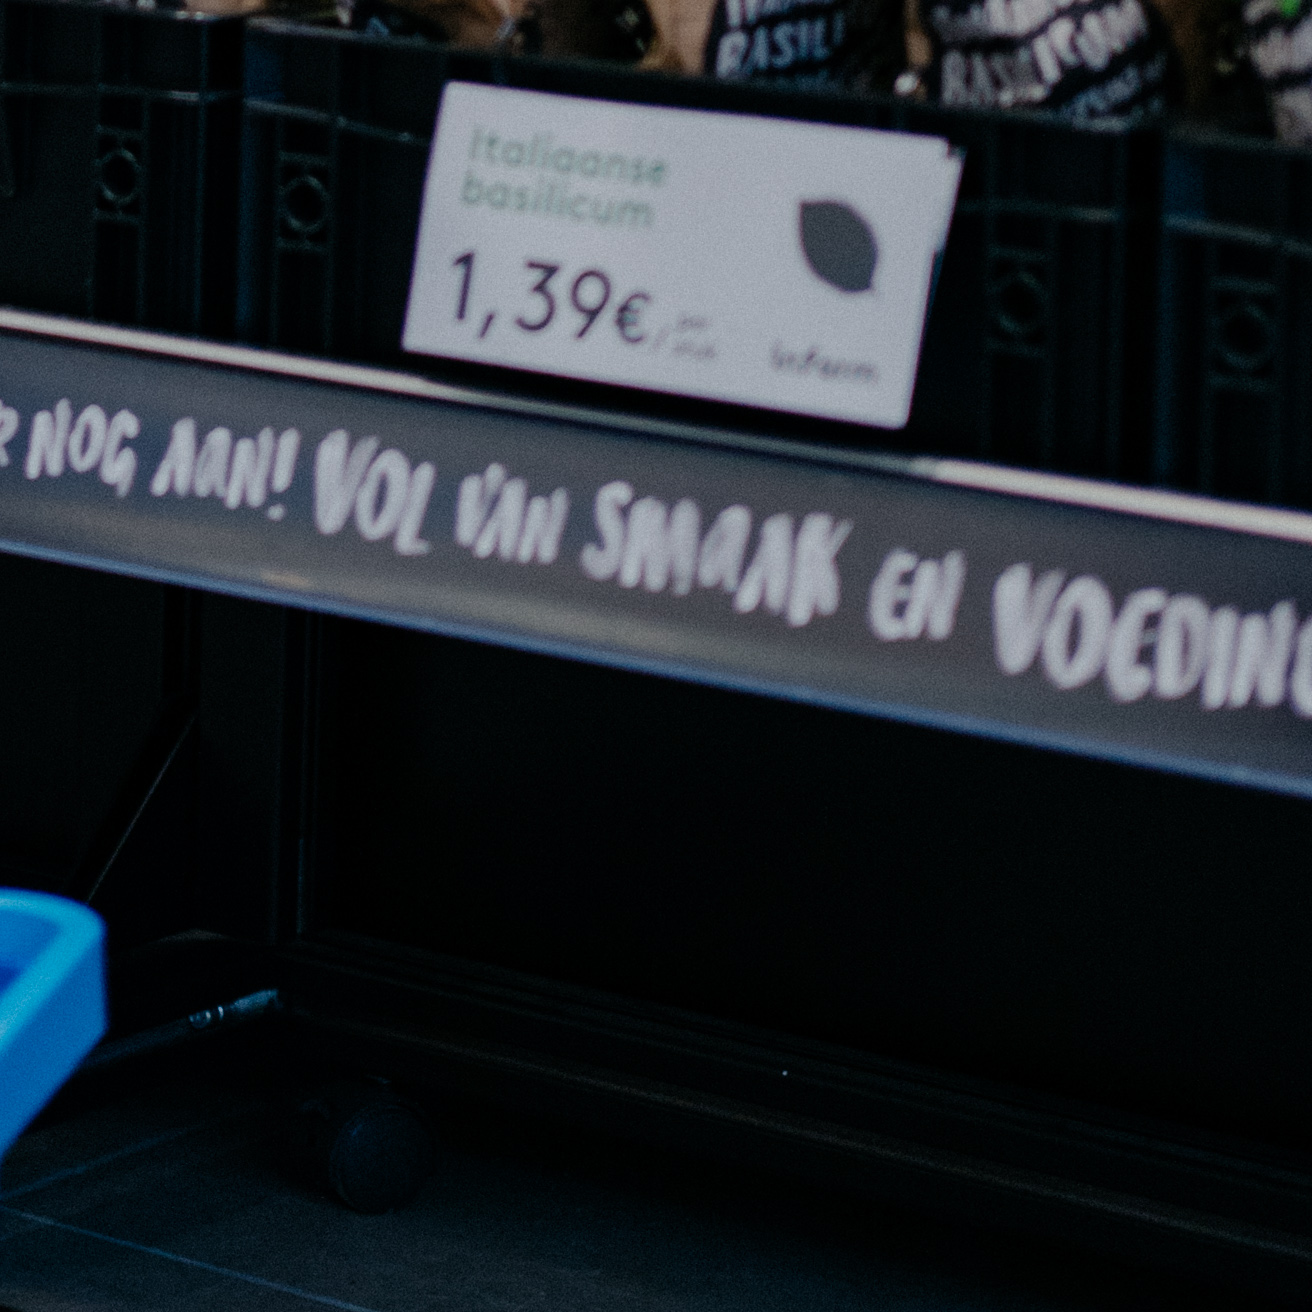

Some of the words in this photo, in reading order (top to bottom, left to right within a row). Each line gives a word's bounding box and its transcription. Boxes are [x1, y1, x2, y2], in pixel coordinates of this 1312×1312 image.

[469, 127, 671, 188] Italiaanse
[460, 172, 655, 230] basilicum
[25, 396, 141, 500] NOG
[150, 414, 301, 523] AAN!
[312, 427, 436, 558] VOL
[454, 460, 570, 565] VAN
[580, 477, 855, 629] SMAAK
[868, 546, 967, 643] EN
